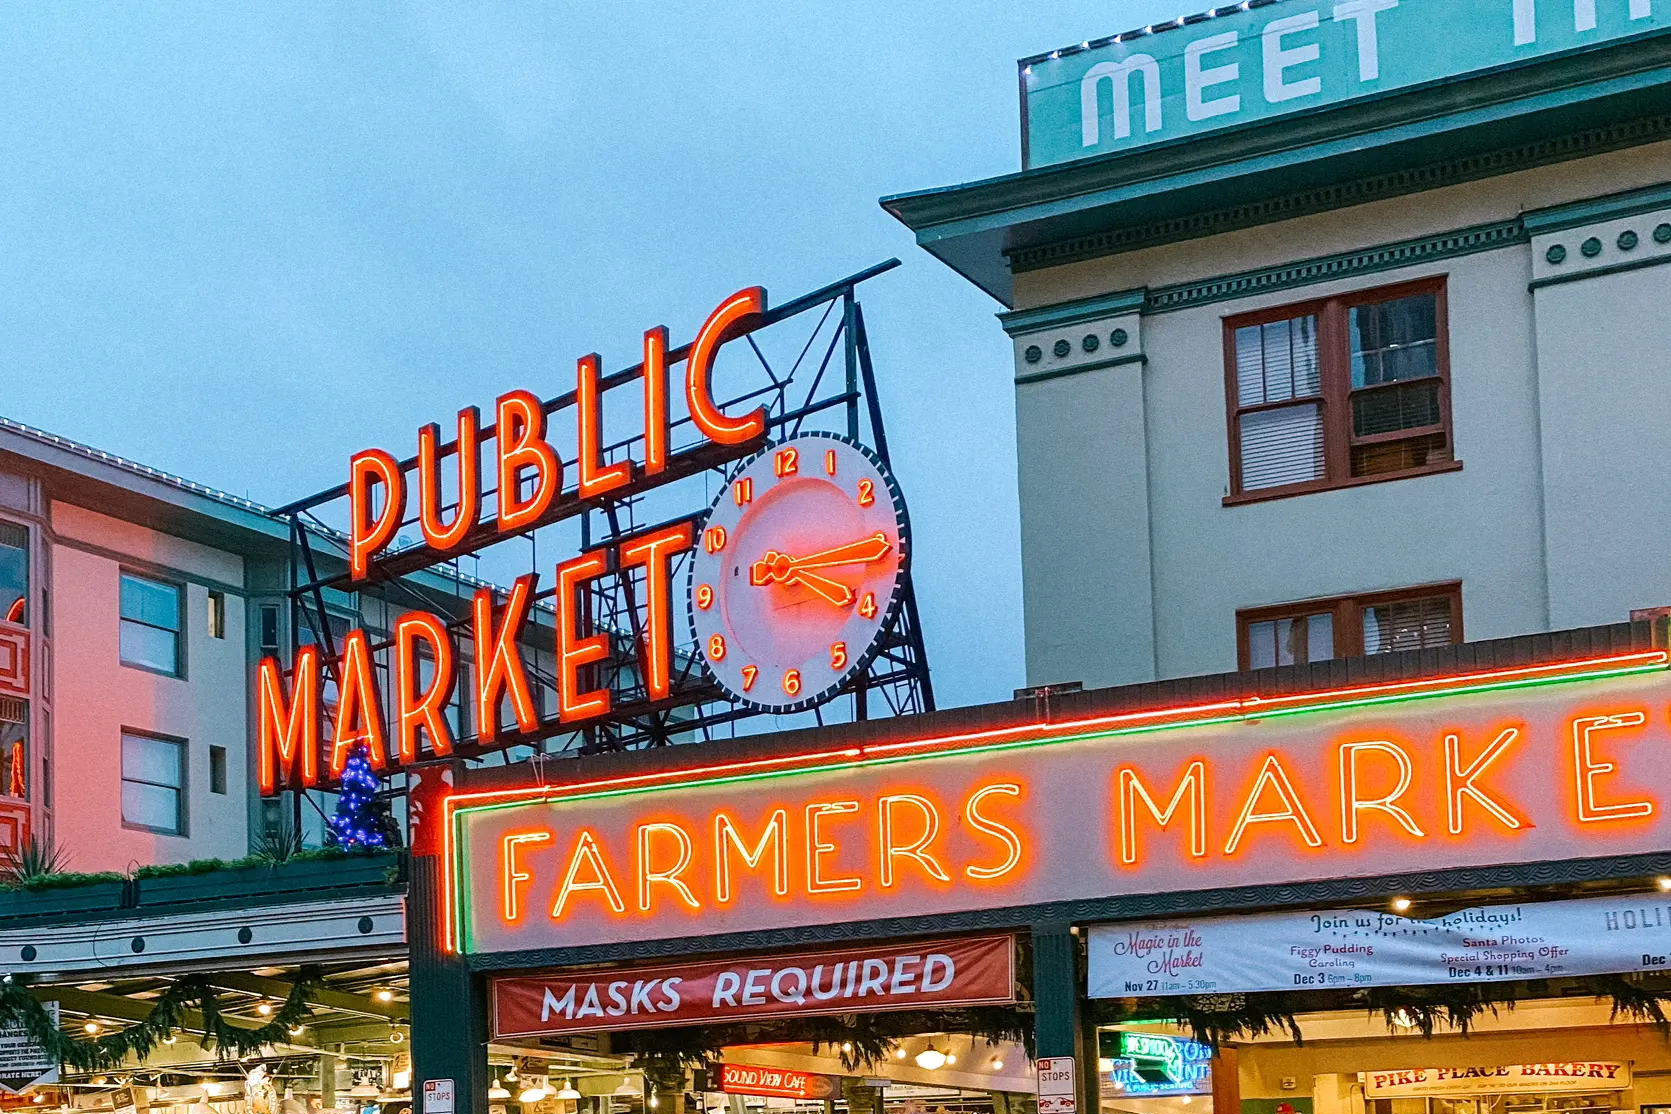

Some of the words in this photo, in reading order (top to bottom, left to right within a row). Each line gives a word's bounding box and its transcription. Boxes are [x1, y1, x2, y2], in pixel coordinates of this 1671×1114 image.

[1080, 0, 1401, 147] MEET
[350, 286, 768, 581] PUBLIC
[774, 447, 798, 477] 12
[825, 450, 836, 476] 1
[733, 477, 752, 507] 11
[857, 478, 875, 507] 2
[705, 525, 727, 554] 10
[697, 583, 713, 610] 9
[858, 592, 877, 619] 4
[258, 522, 692, 796] MARKET
[707, 634, 726, 661] 8
[830, 641, 847, 669] 5
[741, 664, 758, 691] 7
[782, 668, 800, 696] 6
[503, 783, 1022, 920] FARMERS
[1310, 914, 1349, 933] Join
[1356, 917, 1370, 928] us
[1377, 913, 1403, 931] for
[1604, 905, 1671, 931] HOLI
[1114, 931, 1164, 958] Magic
[1167, 934, 1180, 948] in
[1183, 929, 1202, 948] the
[1290, 946, 1321, 959] Figgy
[1323, 944, 1374, 956] Pudding
[1462, 938, 1498, 948] Santa
[1501, 935, 1545, 946] Photos
[1147, 950, 1203, 977] Market
[1308, 958, 1355, 969] Caroling
[1440, 952, 1480, 965] Special
[1483, 950, 1535, 962] Shopping
[1538, 946, 1569, 959] Offer
[1642, 954, 1666, 965] Dec
[1293, 973, 1315, 984] Dec
[1318, 973, 1325, 984] 3
[1327, 974, 1346, 984] 6pm
[1354, 973, 1372, 983] 8pm
[1449, 967, 1471, 978] Dec
[1474, 965, 1482, 976] 4
[1485, 965, 1494, 976] &
[1497, 964, 1509, 975] 11
[541, 977, 684, 1022] MASKS
[712, 954, 955, 1009] REQUIRED
[1124, 981, 1143, 992] Nov
[1146, 980, 1159, 991] 27
[723, 1067, 757, 1085] SOUND
[760, 1070, 782, 1087] VIEW
[1038, 1061, 1049, 1069] NO
[1042, 1072, 1070, 1081] STOPS
[1373, 1069, 1428, 1088] PIKE
[1520, 1062, 1623, 1079] BAKERY
[428, 1092, 450, 1101] STOPS
